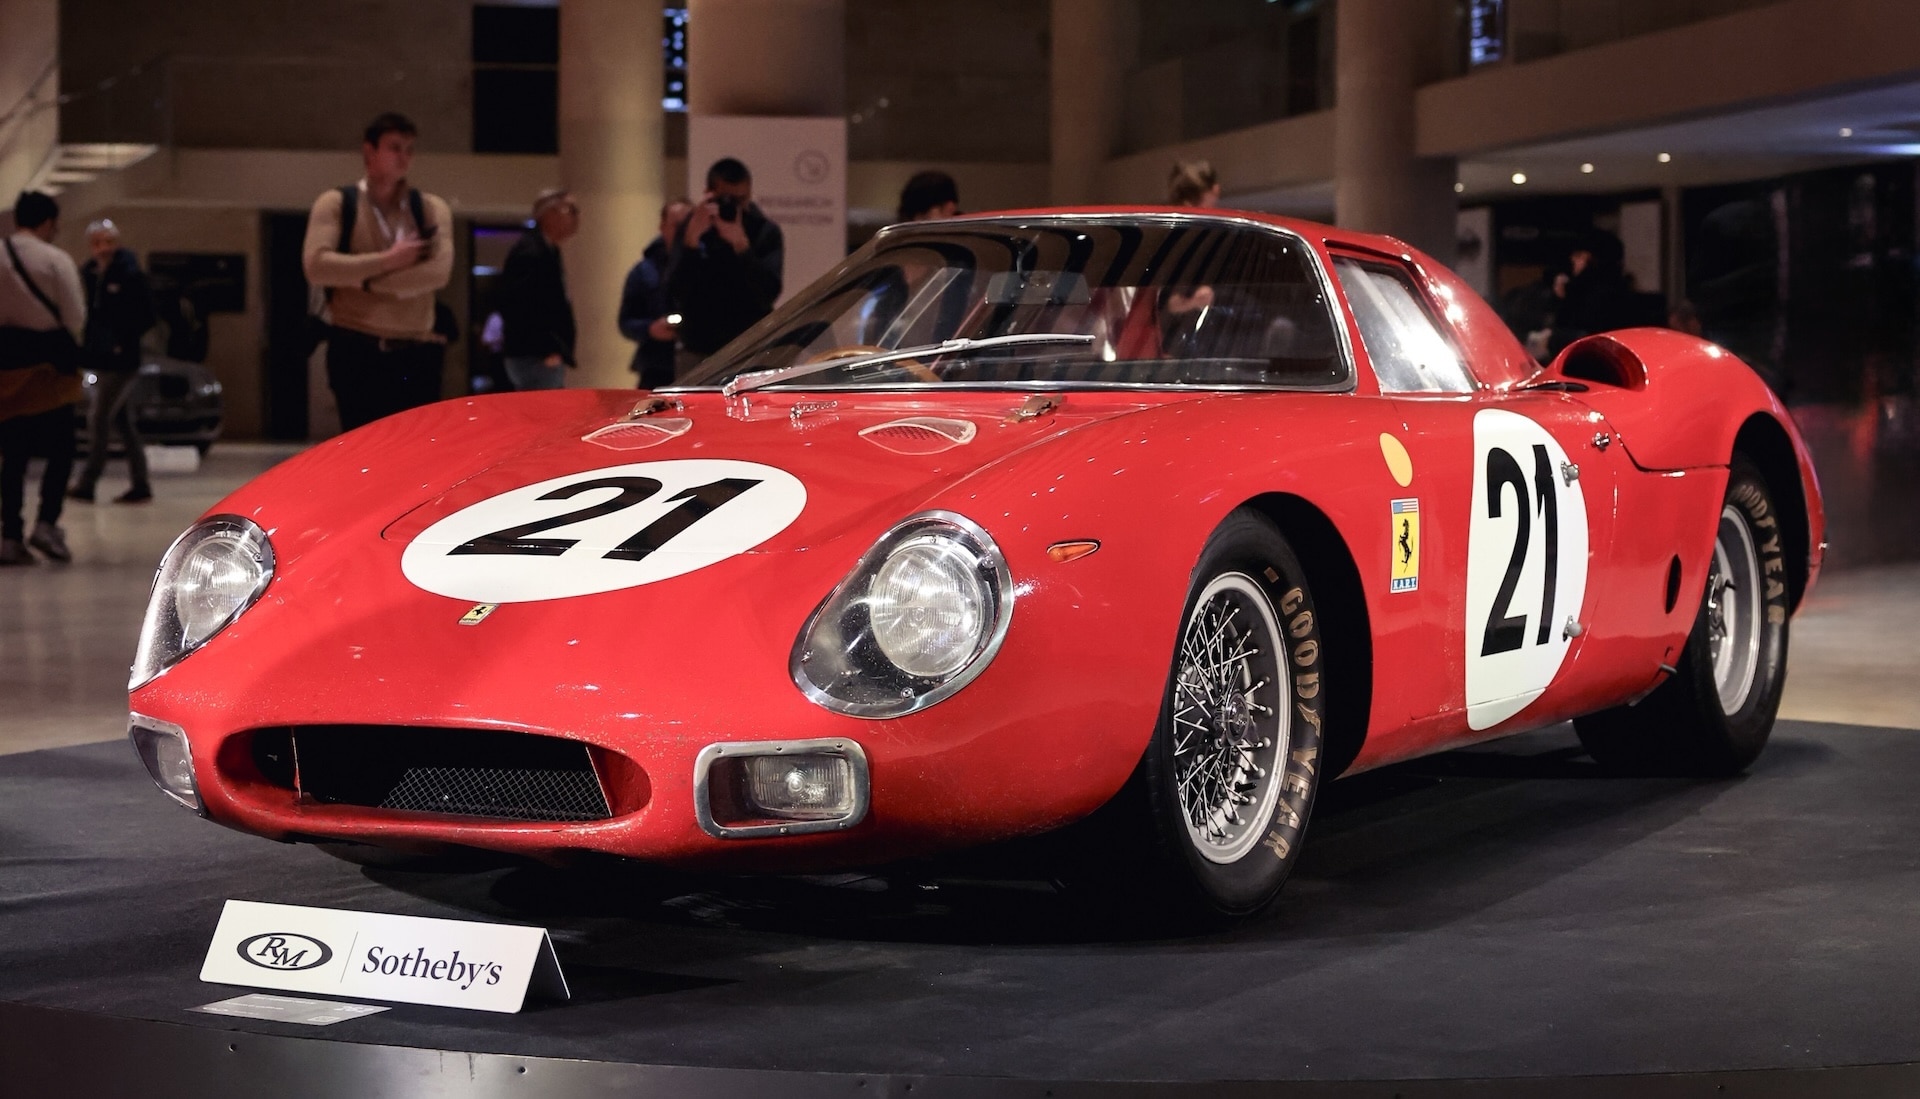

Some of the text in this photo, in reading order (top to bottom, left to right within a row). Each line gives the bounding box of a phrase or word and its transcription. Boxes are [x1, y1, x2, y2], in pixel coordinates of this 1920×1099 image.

[446, 476, 764, 562] 21
[1480, 444, 1558, 657] 21
[256, 936, 503, 991] RM Sotheby's
